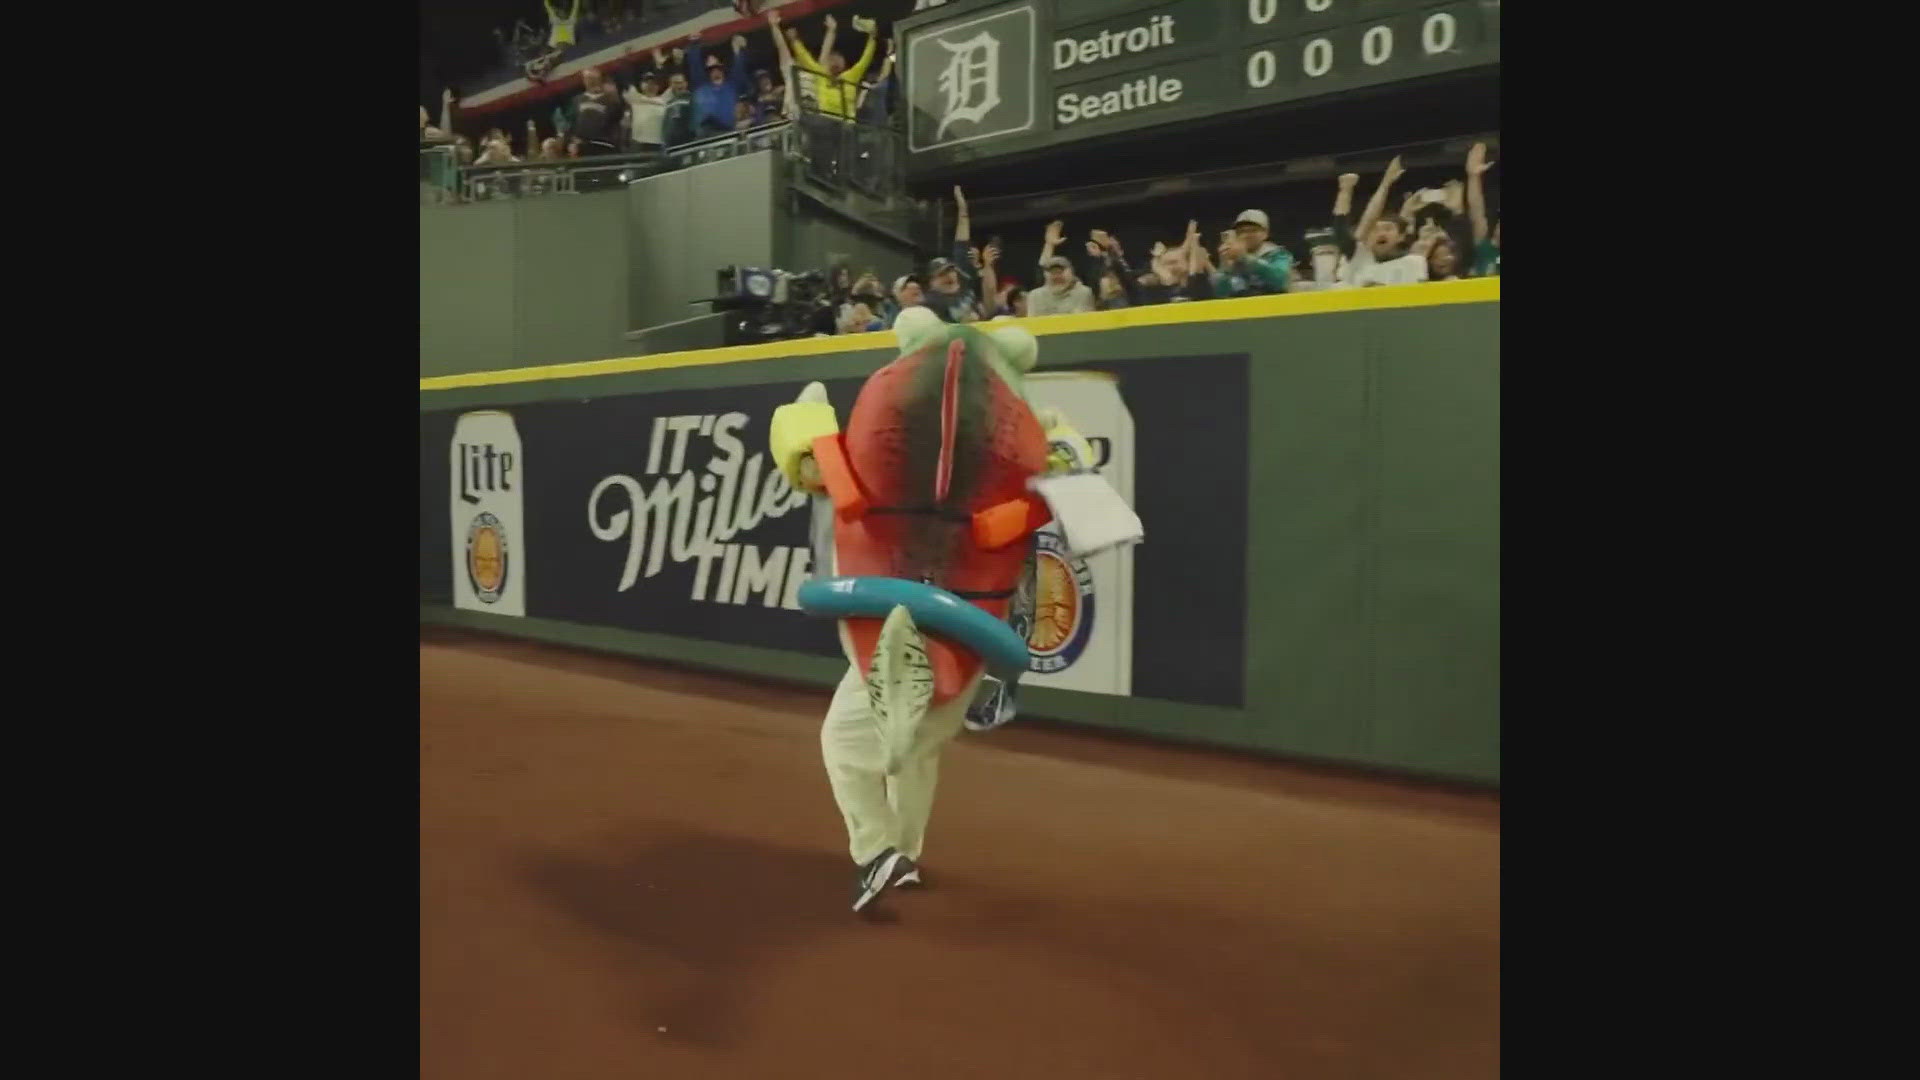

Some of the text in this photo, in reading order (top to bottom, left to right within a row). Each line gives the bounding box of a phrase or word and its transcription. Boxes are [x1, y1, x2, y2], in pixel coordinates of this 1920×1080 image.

[1053, 14, 1175, 70] Detroit
[1056, 12, 1457, 125] Seattle 0 0 0 0
[458, 443, 513, 505] Lite
[645, 411, 751, 476] IT'S
